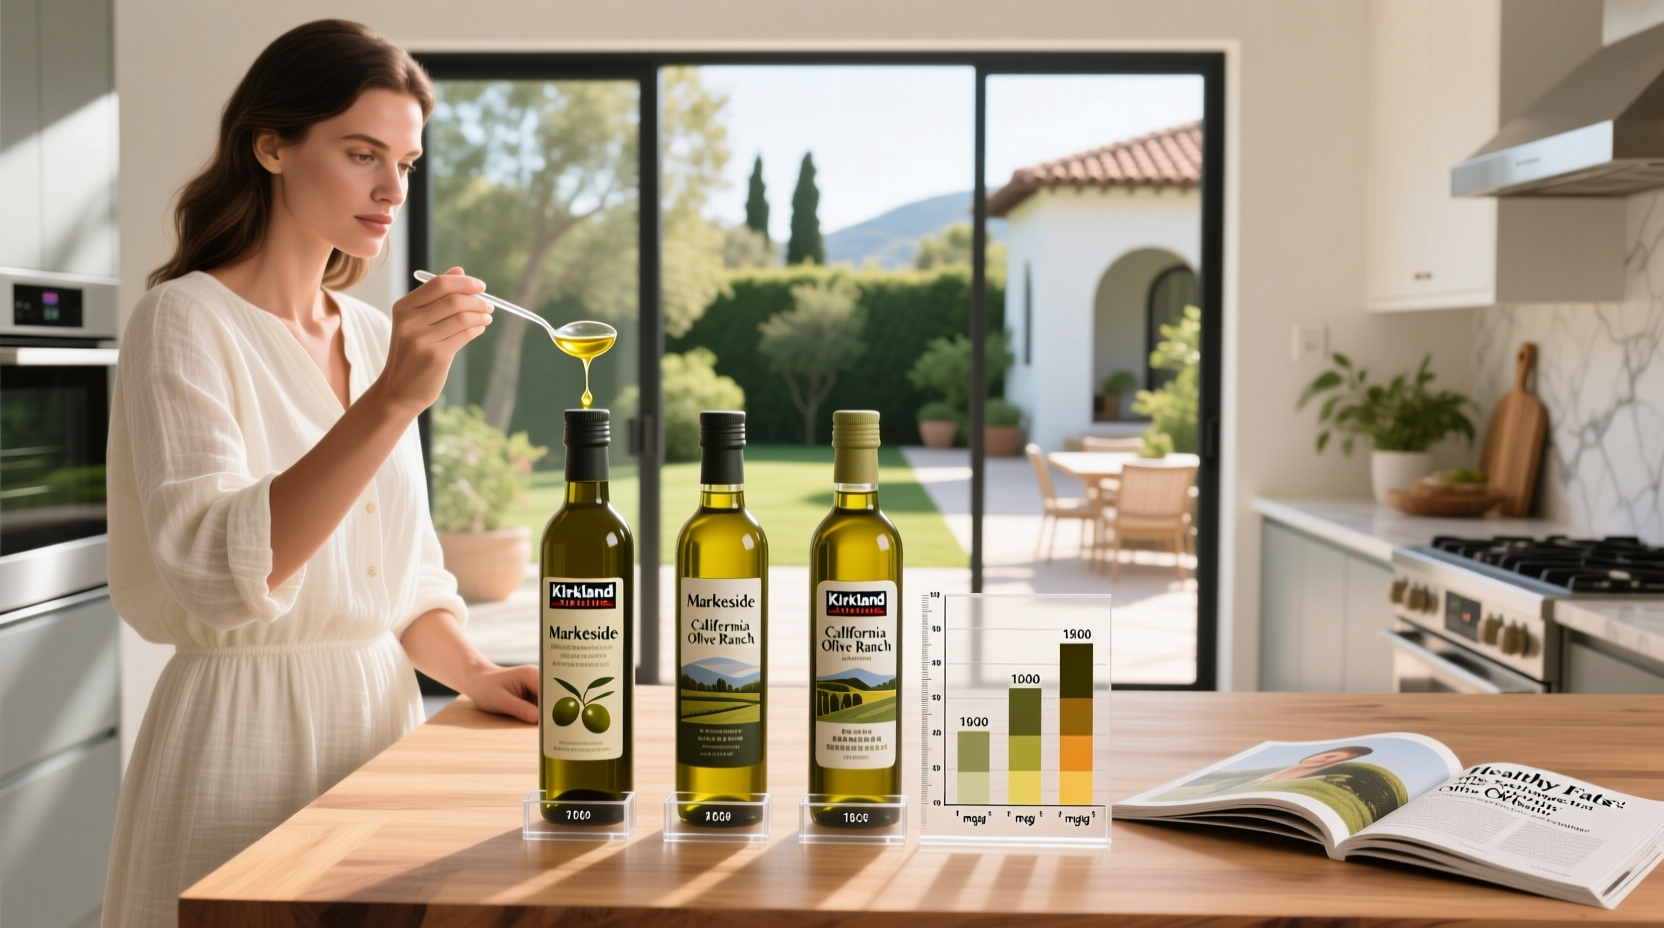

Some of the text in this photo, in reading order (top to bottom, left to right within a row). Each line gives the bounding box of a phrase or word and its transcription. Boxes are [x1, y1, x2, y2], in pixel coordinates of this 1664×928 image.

[552, 584, 614, 598] Kirkland
[687, 593, 756, 608] Markeside
[828, 592, 885, 606] Kirkland
[549, 625, 619, 640] Markeside
[719, 632, 755, 645] Ranch
[856, 639, 892, 653] Ranch
[1011, 674, 1040, 684] 1000
